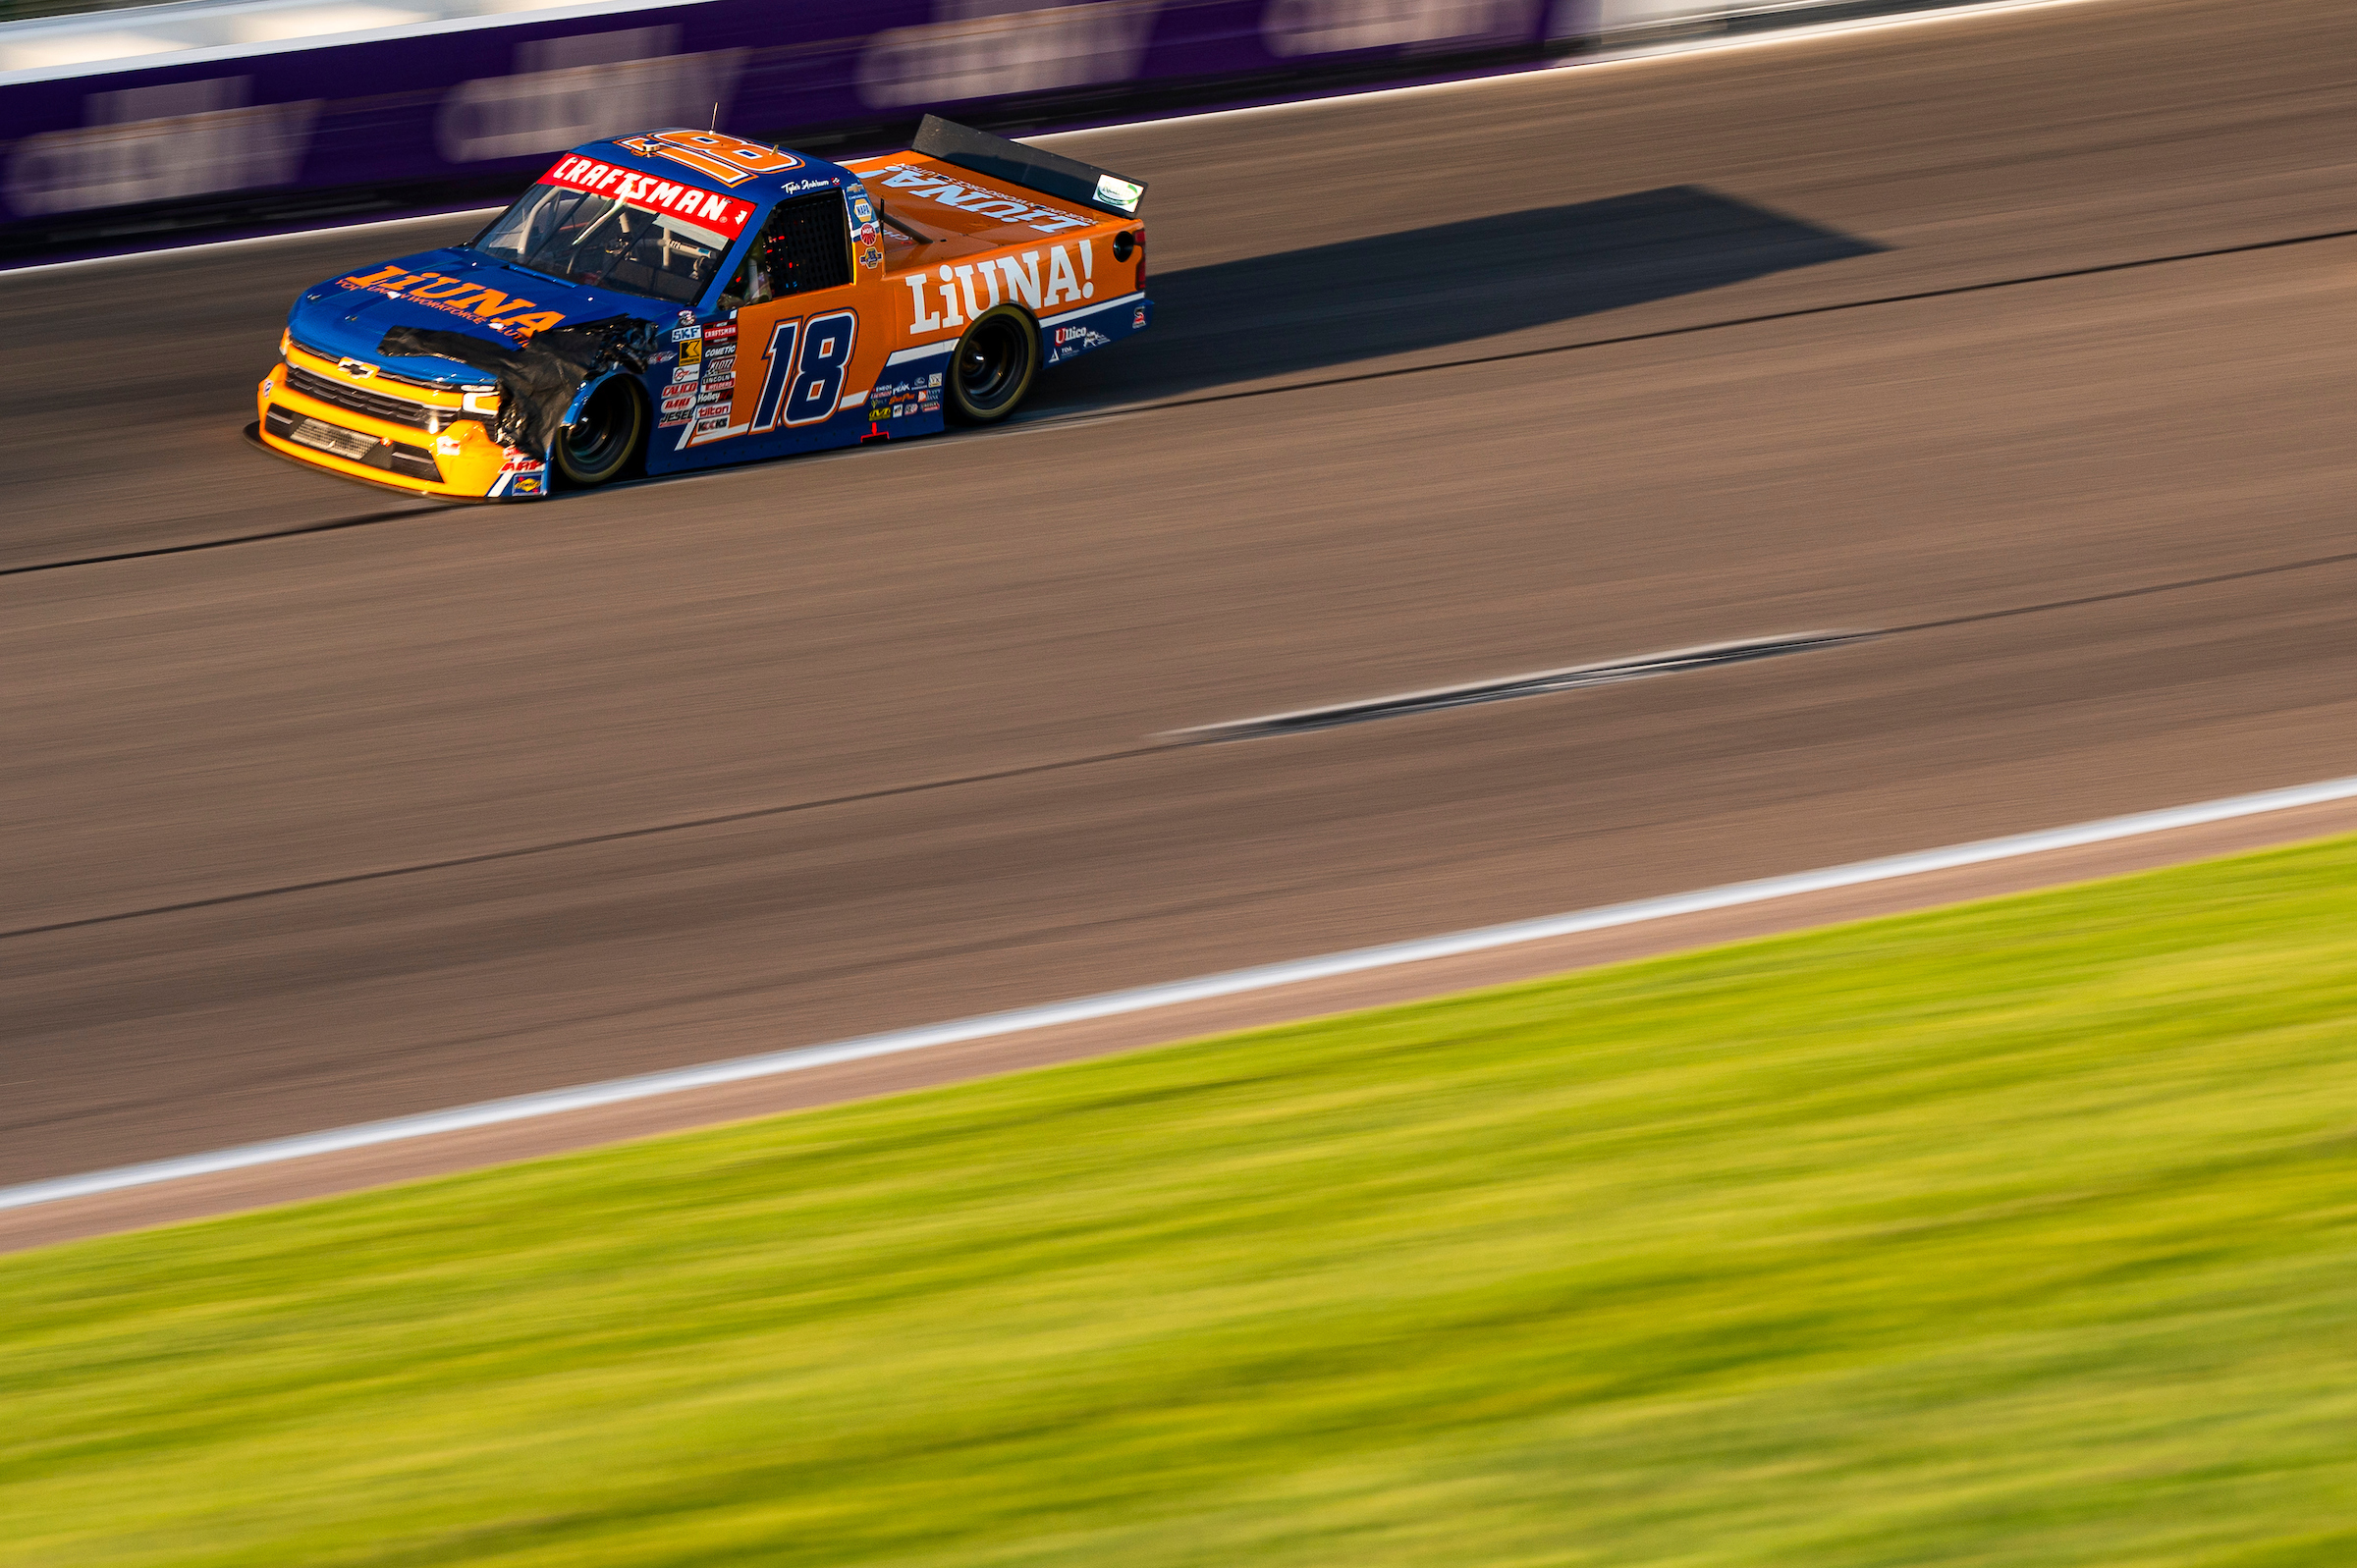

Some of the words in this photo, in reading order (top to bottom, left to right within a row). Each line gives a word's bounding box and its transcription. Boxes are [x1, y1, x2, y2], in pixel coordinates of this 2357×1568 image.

[613, 129, 805, 188] 18
[552, 157, 730, 222] CRAFTSMAN
[855, 164, 1091, 234] LiUNA!
[855, 203, 871, 217] NAPA
[904, 241, 1095, 335] LiUNA!
[673, 327, 700, 341] SKF
[704, 327, 737, 338] CRAFTSMAN
[1055, 325, 1087, 347] Ullico
[749, 306, 859, 435] 18
[702, 373, 731, 385] LINCOLN
[662, 382, 698, 397] CALICO
[696, 391, 721, 404] Holley
[698, 405, 730, 418] tilton
